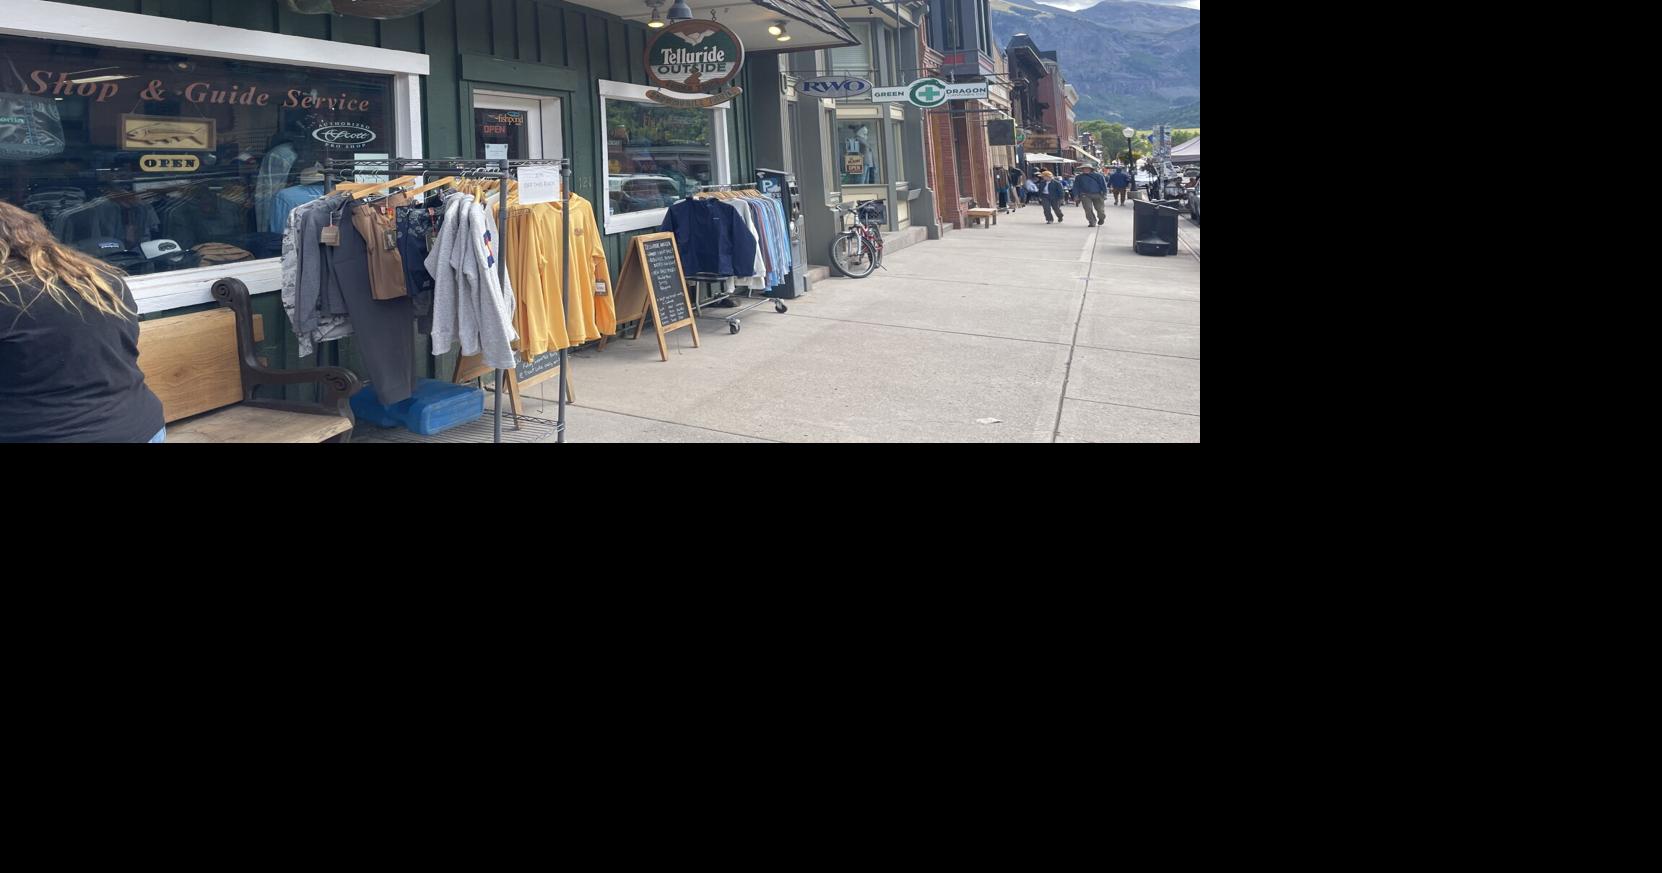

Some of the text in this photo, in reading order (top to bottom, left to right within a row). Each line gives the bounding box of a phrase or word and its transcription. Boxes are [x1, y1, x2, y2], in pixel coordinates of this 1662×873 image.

[661, 45, 725, 65] Telluride
[802, 79, 865, 92] RWO
[29, 70, 369, 112] Shop & Guide Service
[945, 87, 986, 95] DRAGON
[318, 121, 371, 129] AUTHORIZED
[484, 126, 506, 134] OPEN
[144, 159, 196, 168] OPEN
